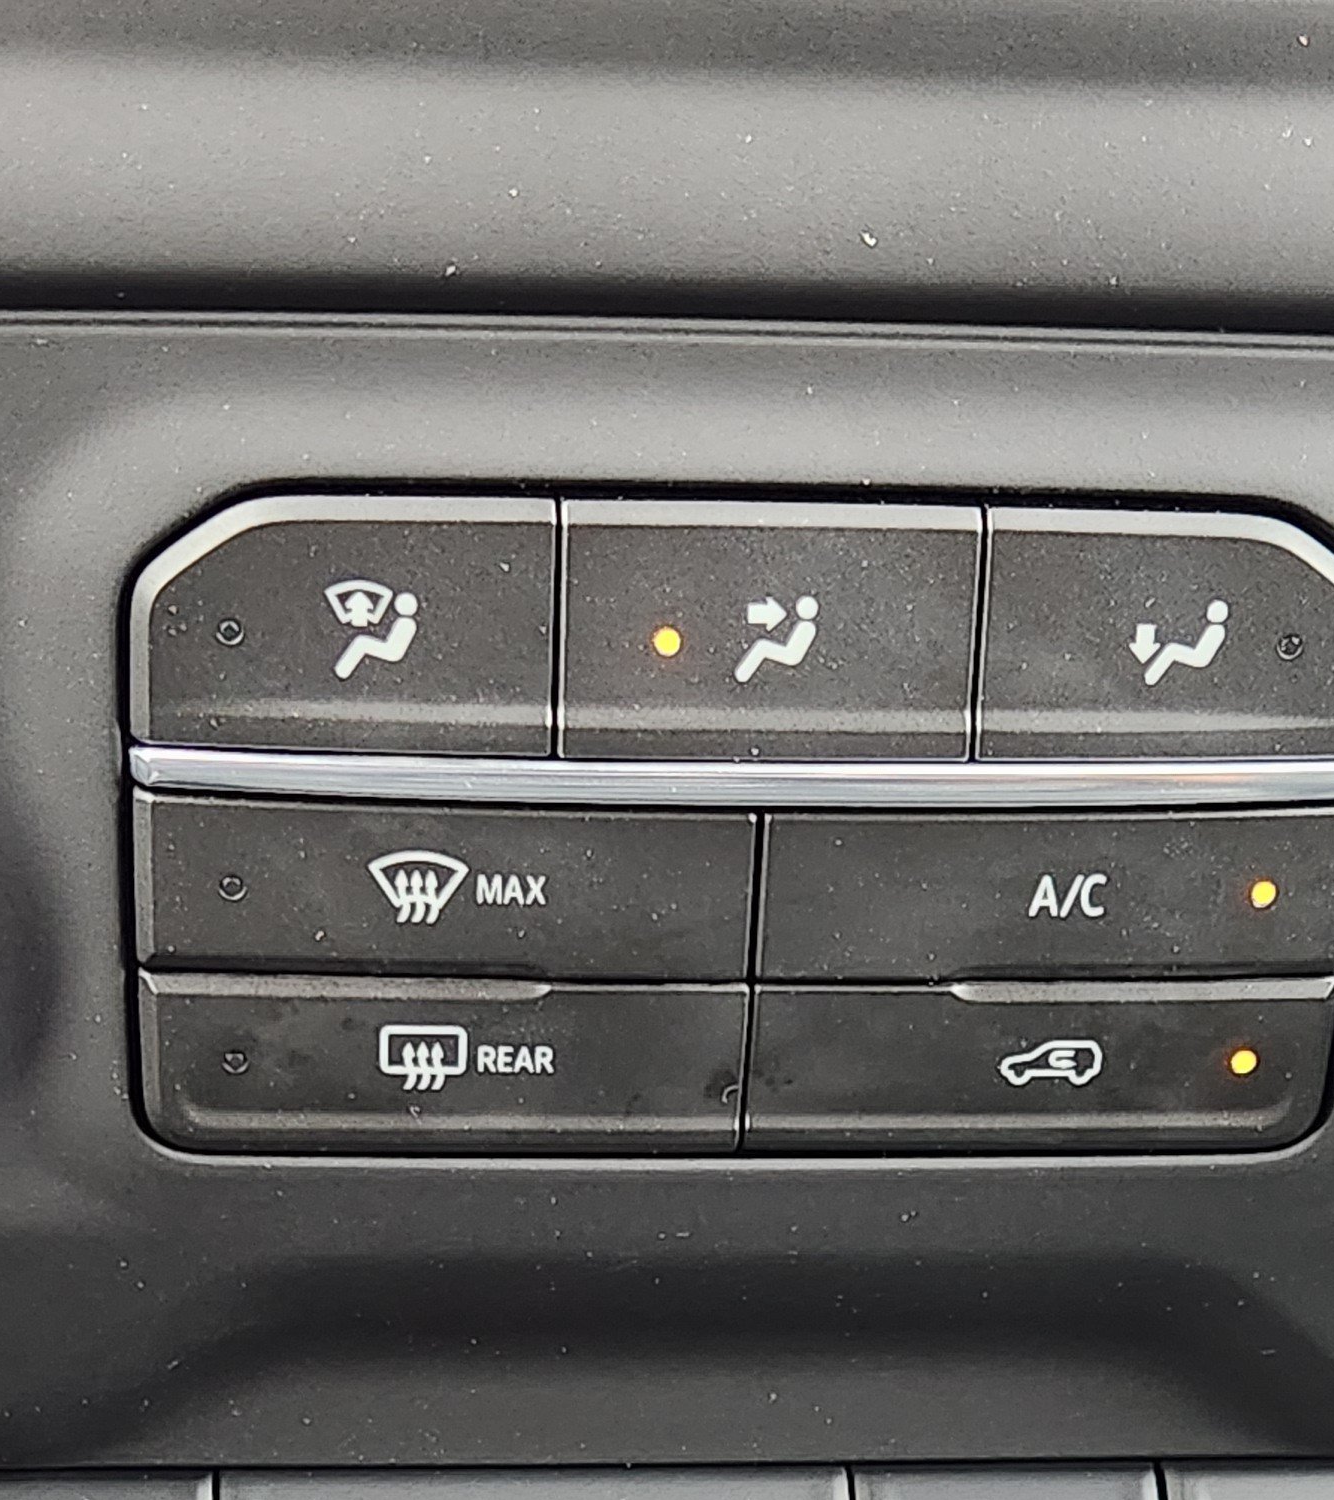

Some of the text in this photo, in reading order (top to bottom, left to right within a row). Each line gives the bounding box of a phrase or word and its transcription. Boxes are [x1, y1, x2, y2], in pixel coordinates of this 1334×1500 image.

[475, 874, 547, 906] MAX
[1028, 874, 1107, 918] A/C
[476, 1044, 555, 1074] REAR
